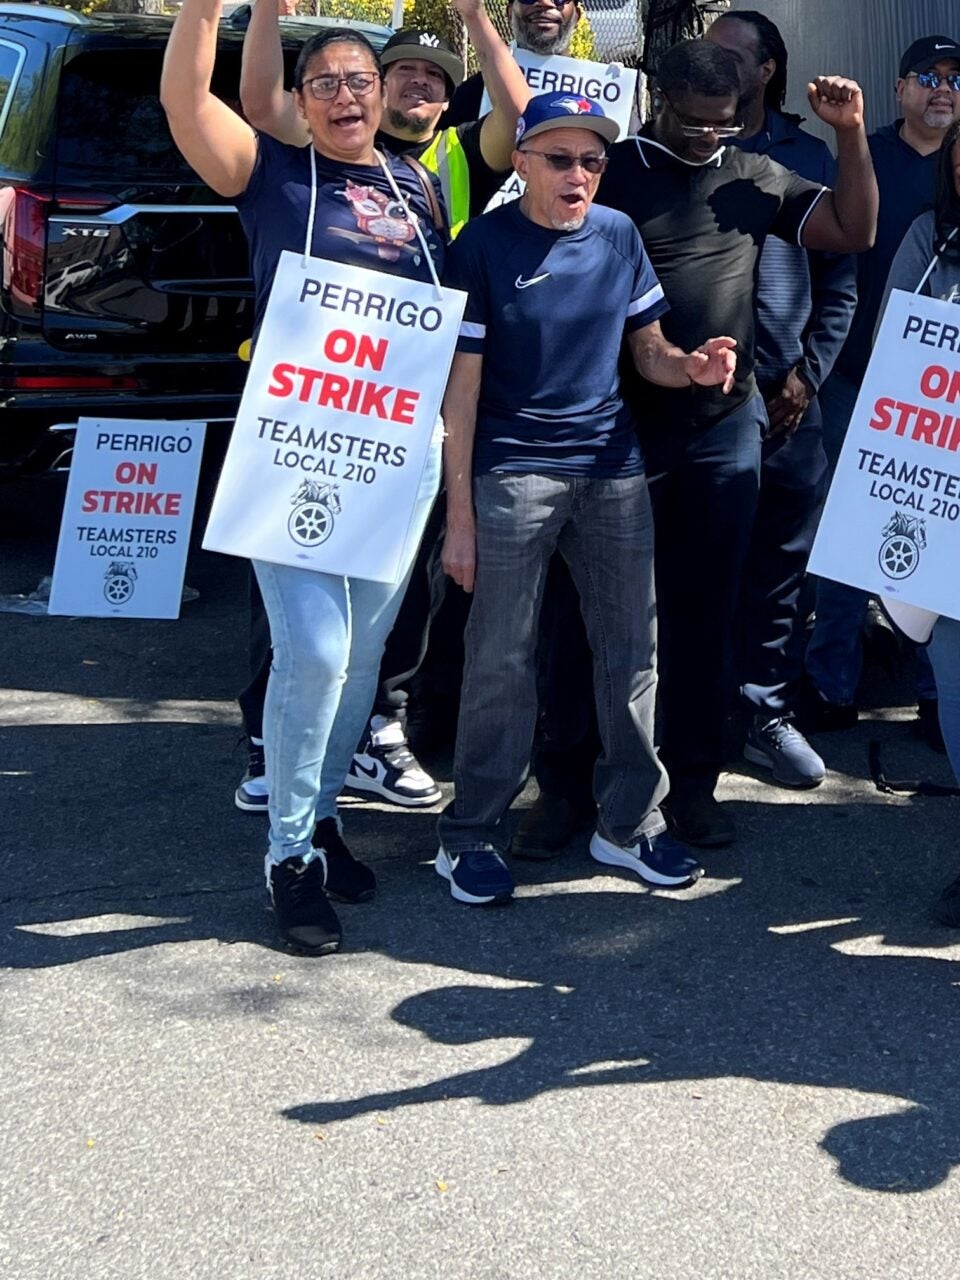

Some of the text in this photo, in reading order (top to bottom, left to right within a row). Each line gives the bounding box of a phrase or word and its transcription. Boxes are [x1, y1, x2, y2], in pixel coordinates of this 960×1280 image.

[62, 227, 110, 238] XT6
[298, 277, 443, 332] PERRIGO
[323, 329, 389, 372] ON
[267, 362, 421, 425] STRIKE
[96, 432, 193, 454] PERRIGO
[257, 416, 407, 468] TEAMSTERS
[115, 461, 158, 485] ON
[273, 447, 377, 485] LOCAL 210
[81, 489, 182, 516] STRIKE
[869, 479, 960, 522] LOCAL 210
[76, 526, 177, 545] TEAMSTERS
[89, 544, 159, 559] LOCAL 210
